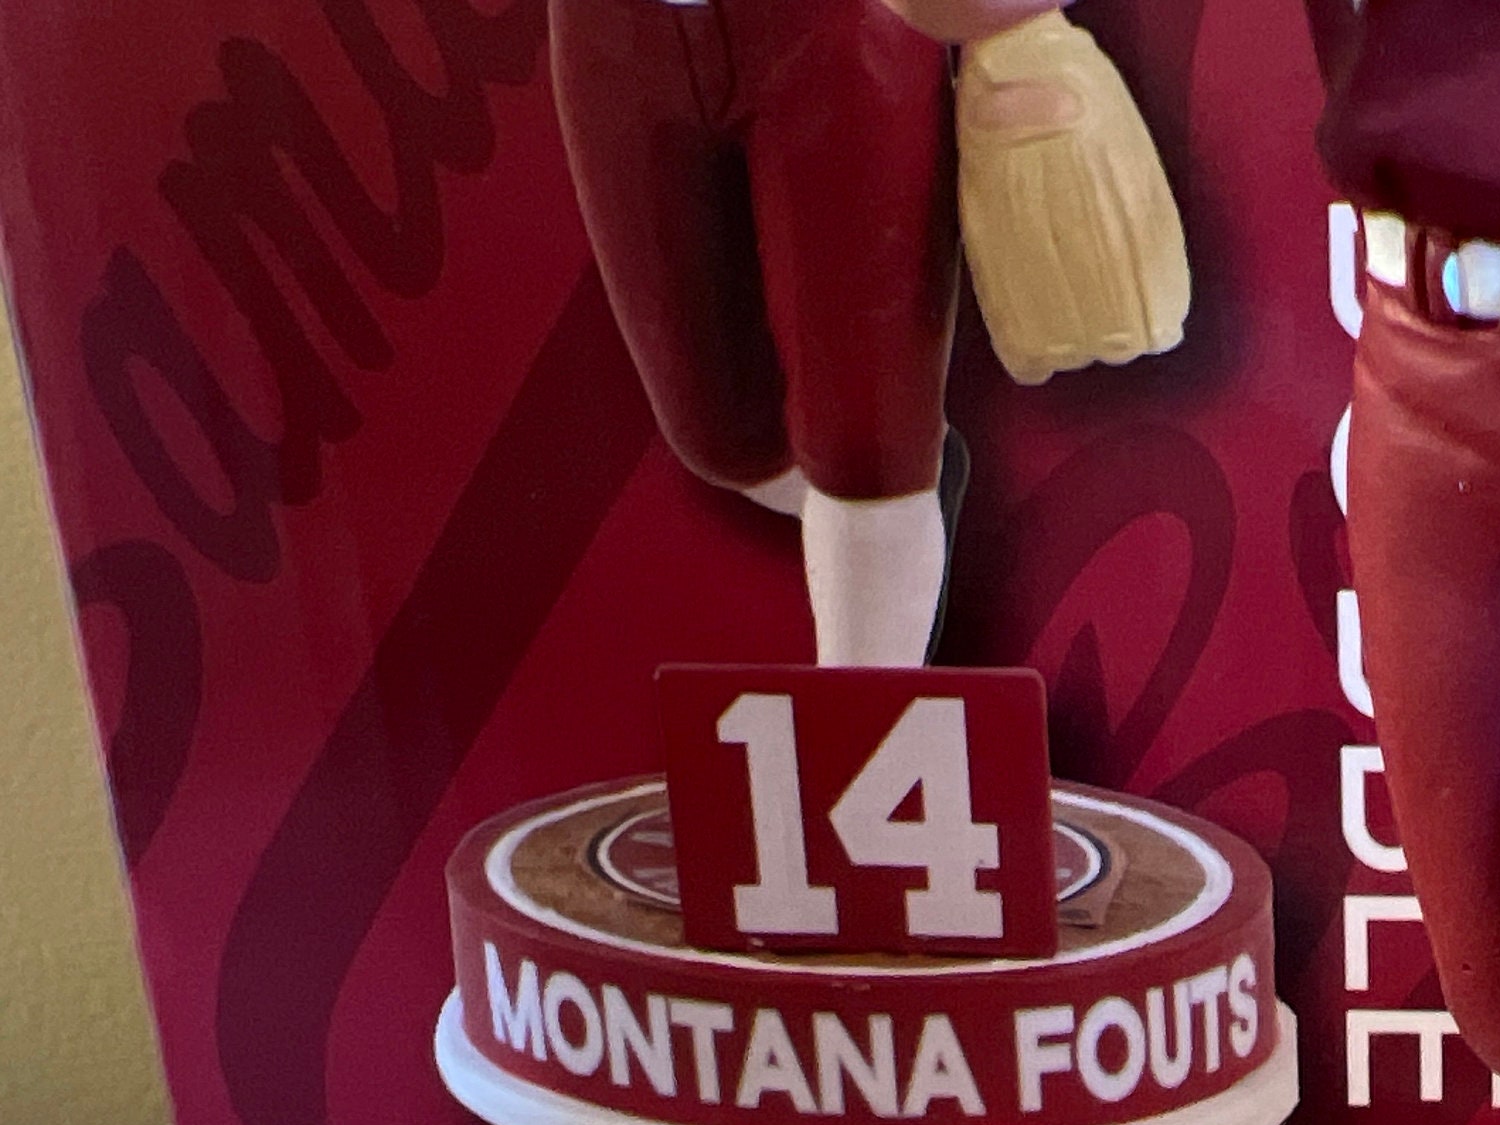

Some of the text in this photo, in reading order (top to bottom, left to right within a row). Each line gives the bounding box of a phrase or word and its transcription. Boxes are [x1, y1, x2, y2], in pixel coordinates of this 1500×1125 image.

[716, 693, 1004, 939] 14
[482, 939, 1260, 1118] MONTANA FOUTS
